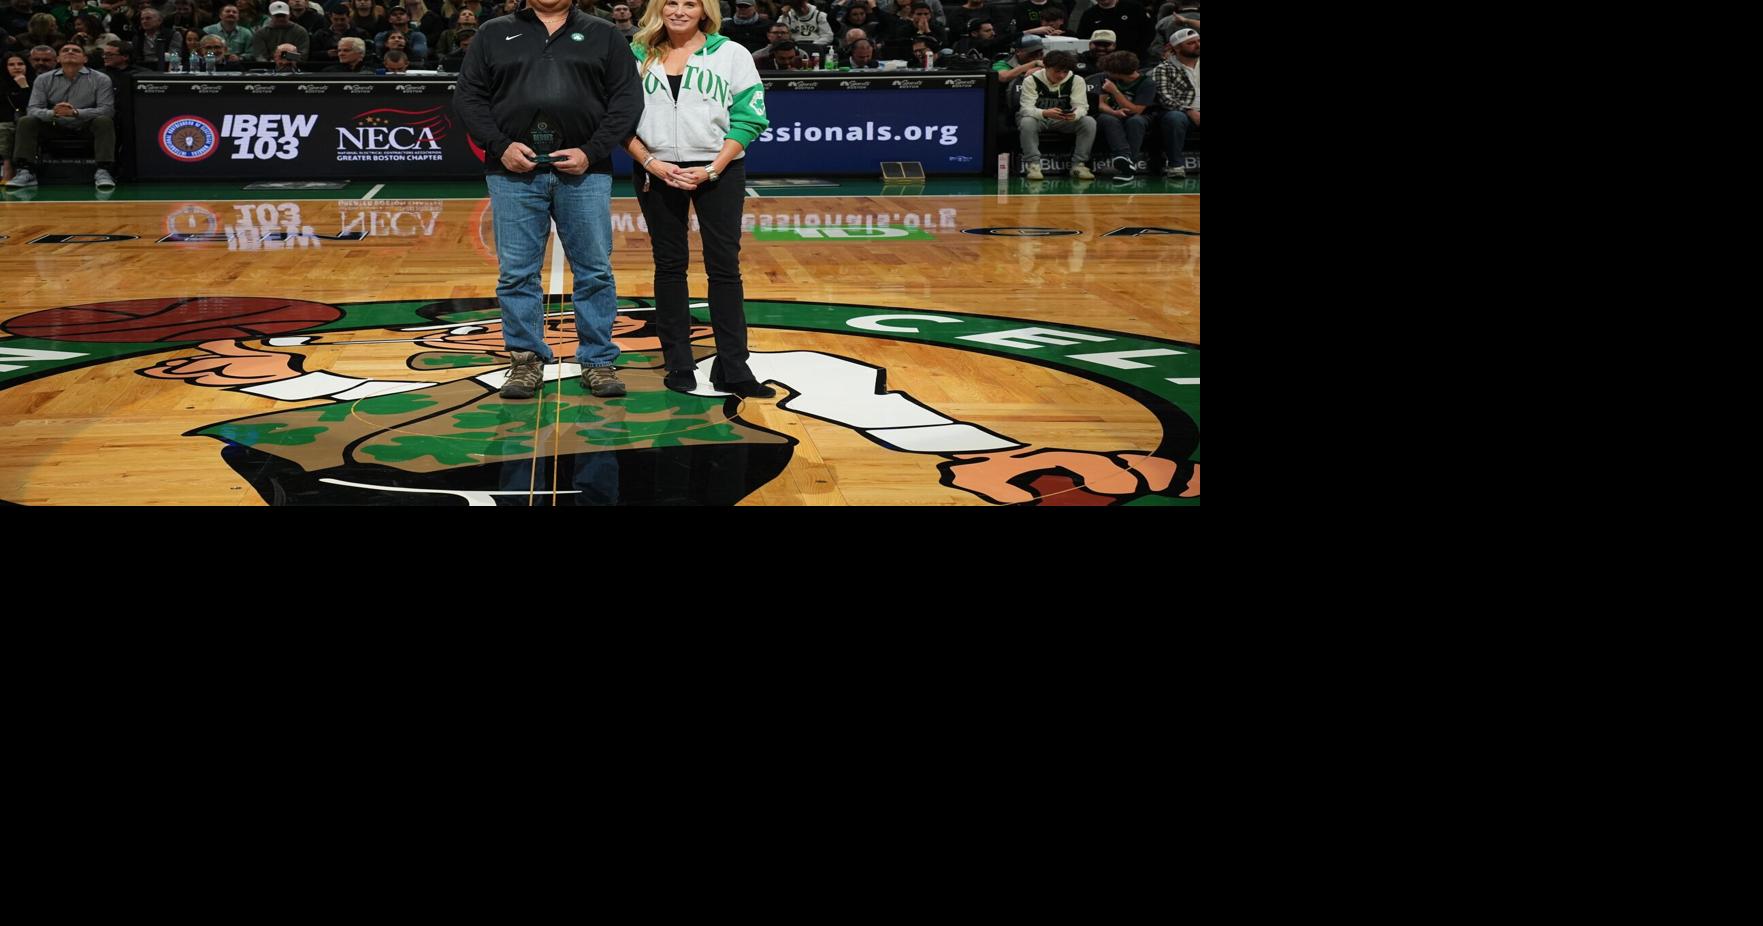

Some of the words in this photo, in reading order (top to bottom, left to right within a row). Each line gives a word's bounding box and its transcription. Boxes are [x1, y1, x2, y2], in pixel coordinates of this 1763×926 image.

[221, 114, 318, 137] IBEW
[750, 121, 958, 146] ssionals.org
[231, 137, 299, 160] 103
[336, 126, 441, 150] NECA
[0, 231, 368, 244] DEN
[846, 313, 1200, 386] CEL
